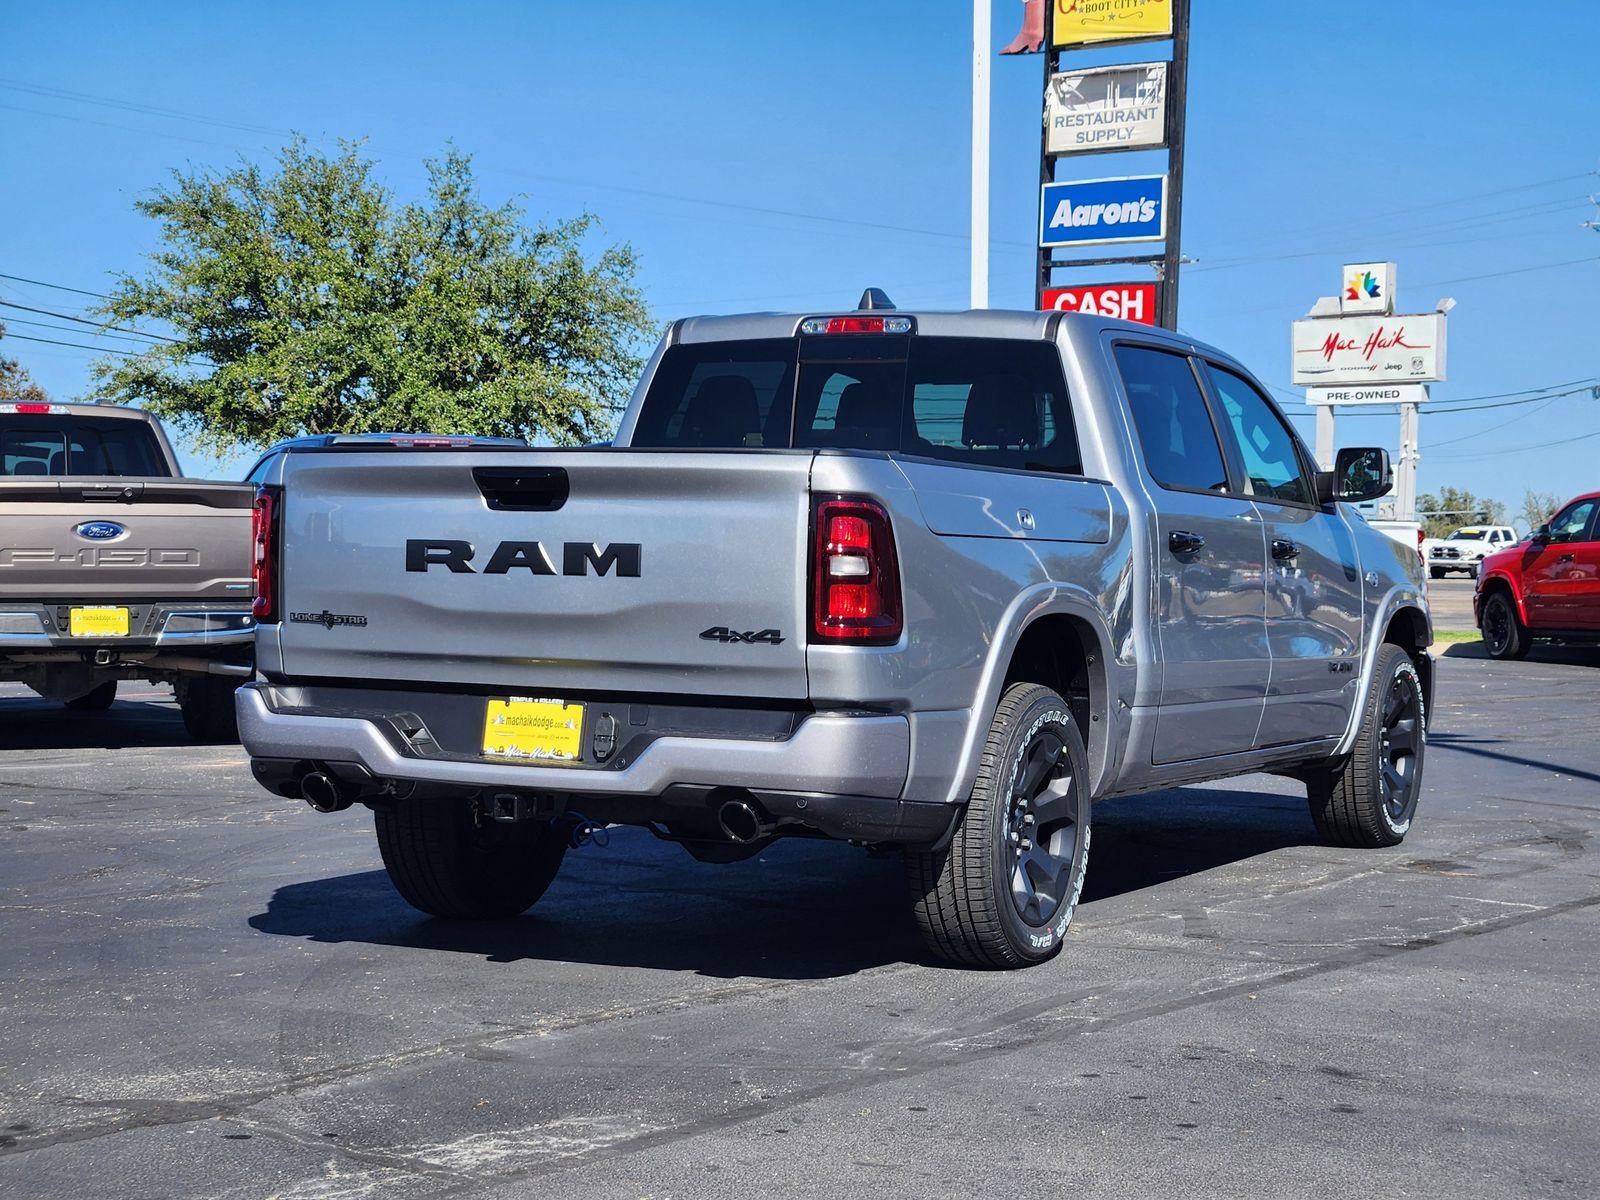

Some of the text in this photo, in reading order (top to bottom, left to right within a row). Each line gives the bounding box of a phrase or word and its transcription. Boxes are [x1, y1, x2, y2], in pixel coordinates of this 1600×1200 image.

[1085, 1, 1111, 13] BOOT
[1114, 0, 1138, 9] CITY
[1055, 107, 1158, 128] RESTAURANT
[1075, 127, 1135, 143] SUPPLY
[1049, 197, 1156, 228] Aaron's
[1054, 290, 1144, 320] CASH
[1321, 326, 1407, 362] Mac Haik
[1384, 363, 1402, 371] Jeep
[1327, 389, 1400, 400] PRE-OWNED
[88, 526, 114, 537] Ford
[0, 548, 200, 567] F-150
[406, 539, 641, 578] RAM
[290, 612, 367, 627] LONE STAR
[700, 626, 785, 645] 4x4
[505, 714, 564, 730] machaikdodge.com
